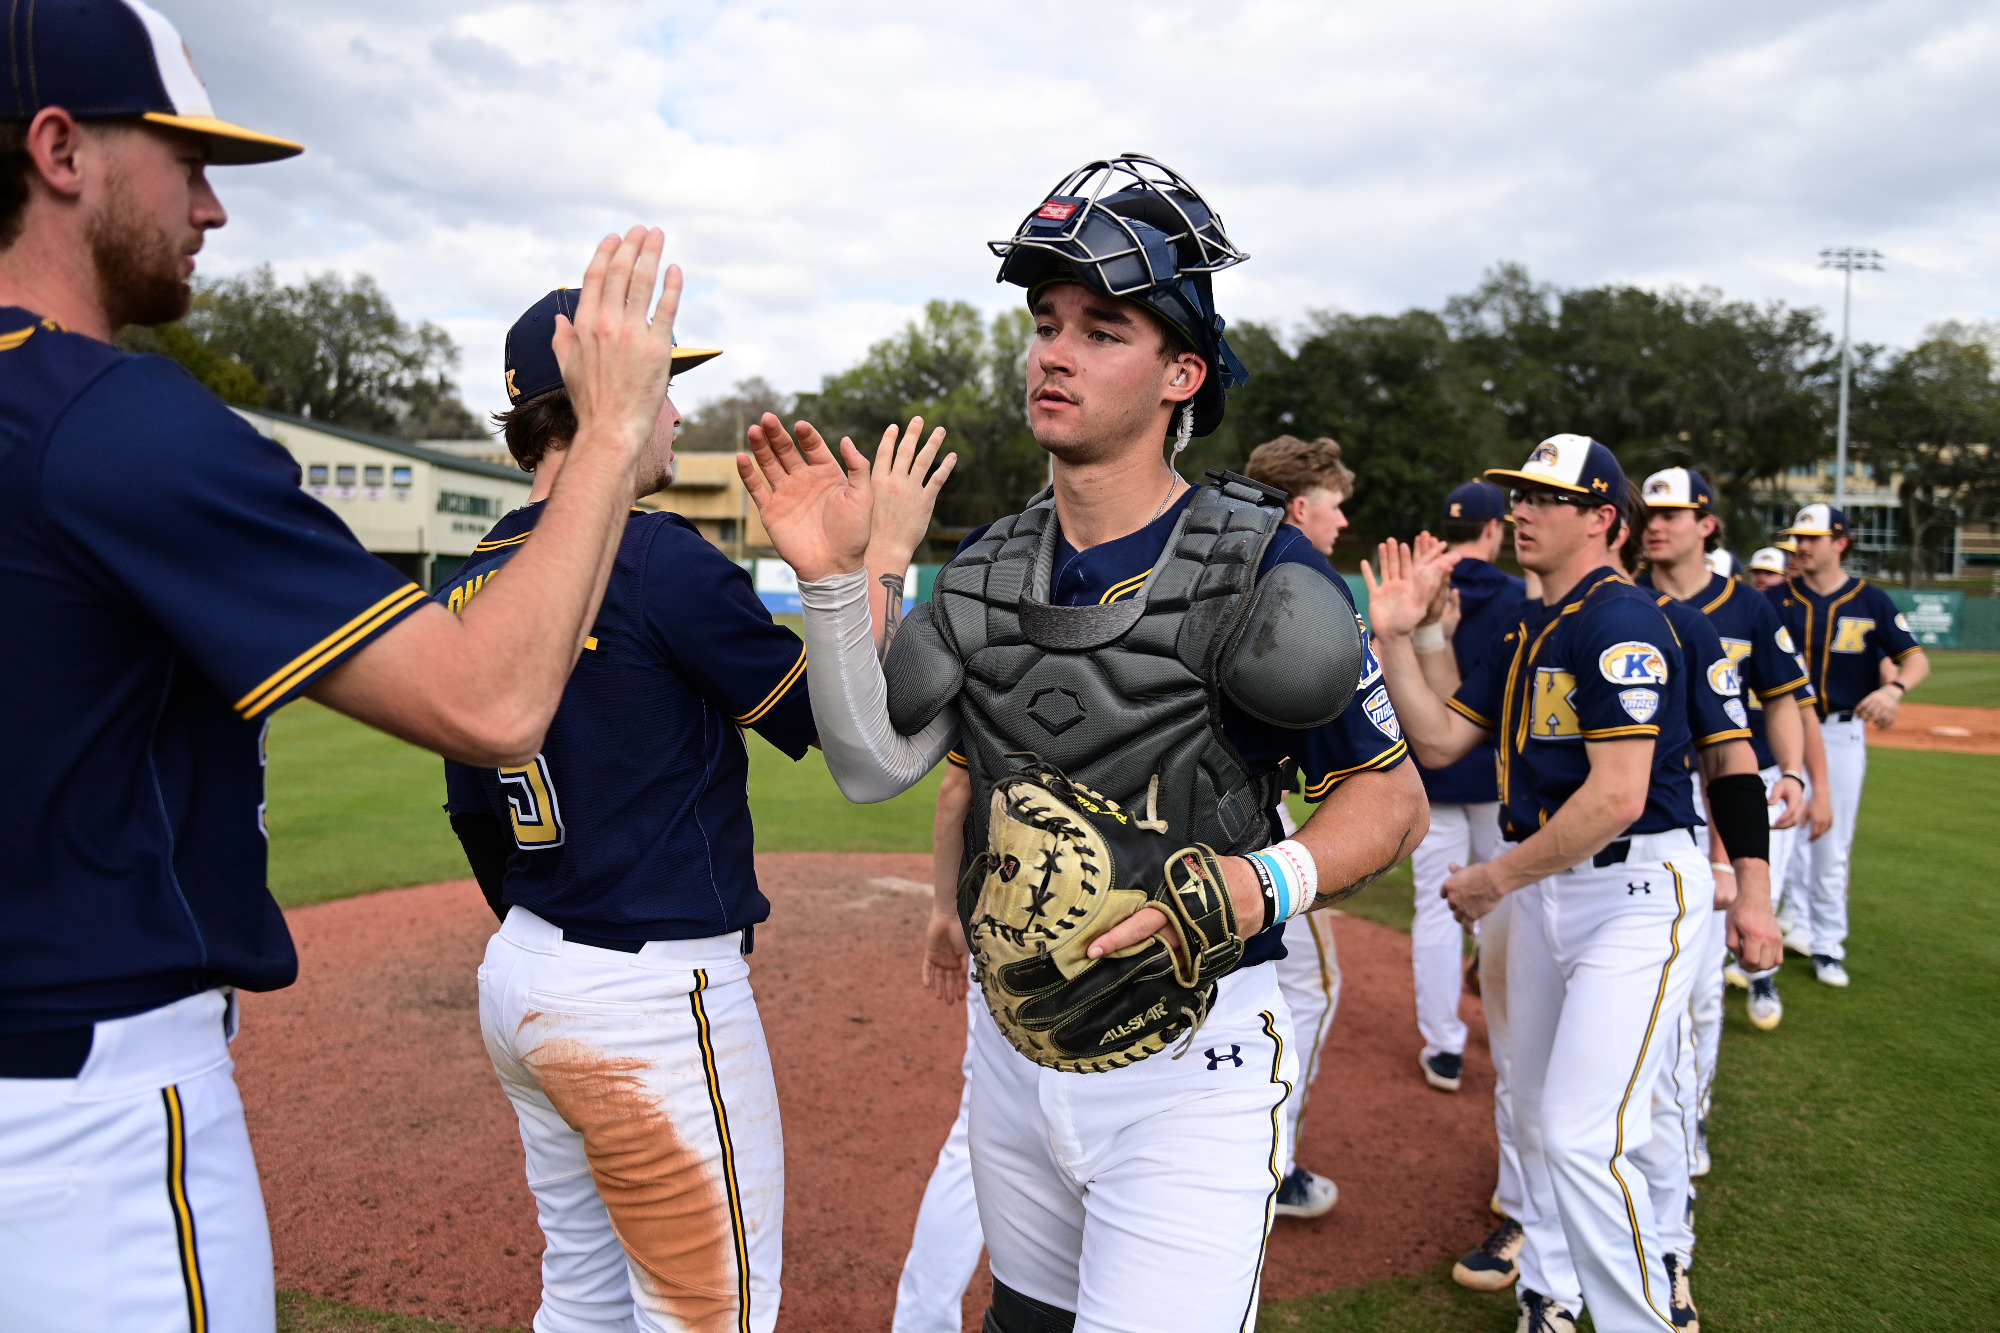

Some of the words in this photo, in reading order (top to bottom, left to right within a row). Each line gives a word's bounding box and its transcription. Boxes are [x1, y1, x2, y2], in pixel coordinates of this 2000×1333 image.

[1830, 616, 1876, 654] K
[1622, 654, 1652, 678] K
[1530, 667, 1583, 740] K
[1099, 1002, 1168, 1046] ALL-STAR
